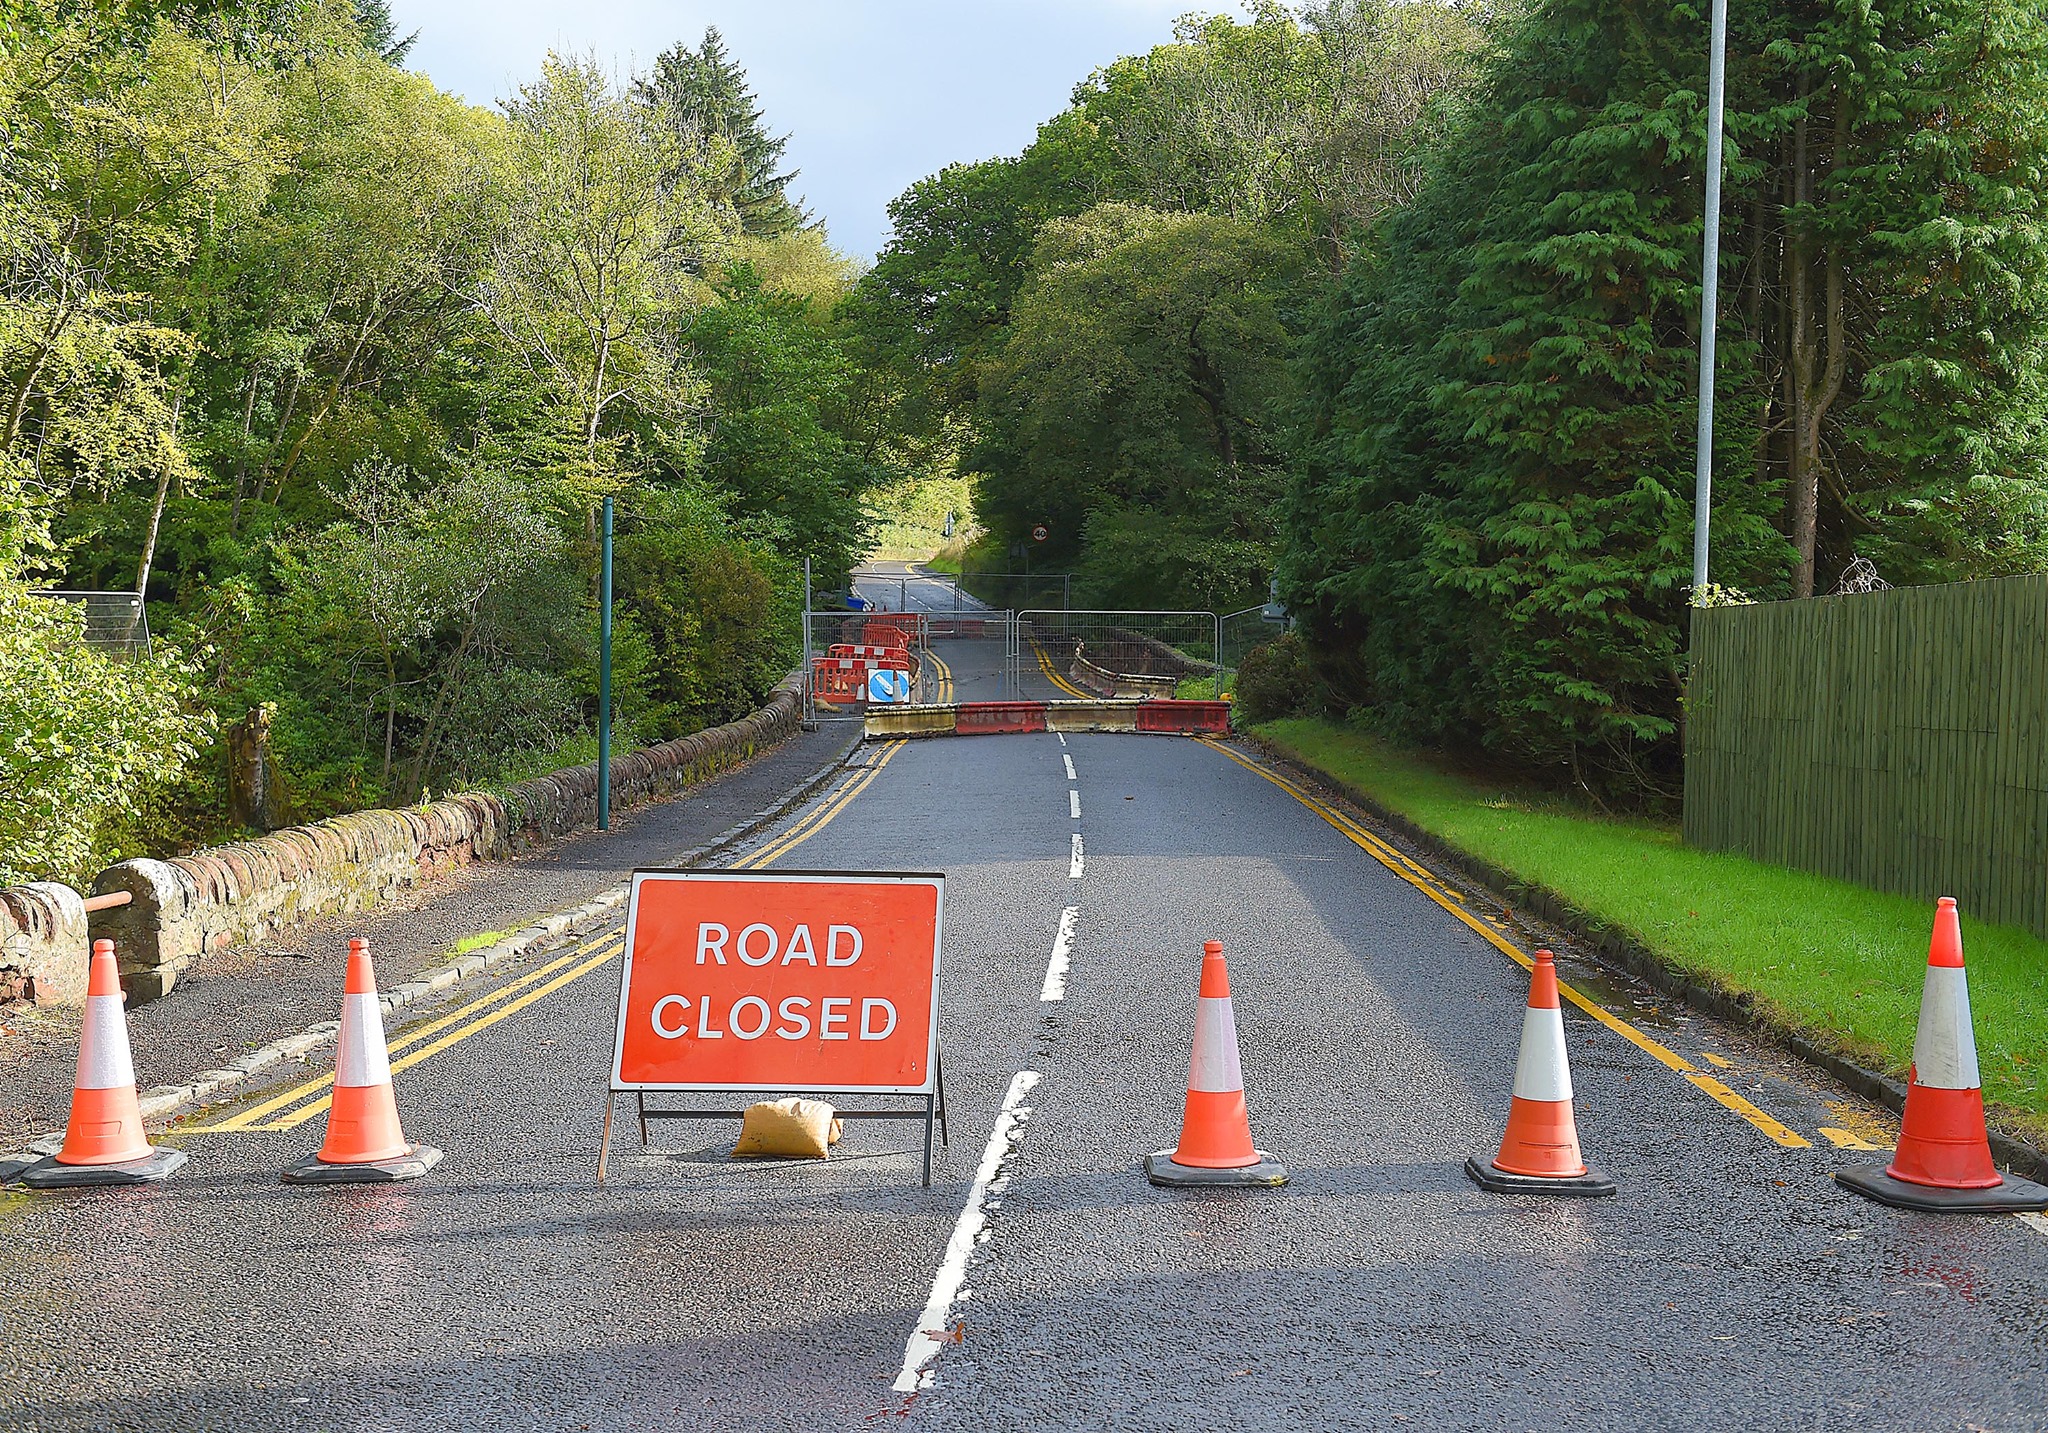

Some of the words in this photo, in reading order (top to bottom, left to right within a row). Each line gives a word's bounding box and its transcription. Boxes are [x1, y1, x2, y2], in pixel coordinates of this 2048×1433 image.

[1034, 529, 1047, 538] 40
[695, 922, 864, 967] ROAD
[650, 994, 898, 1040] CLOSED
